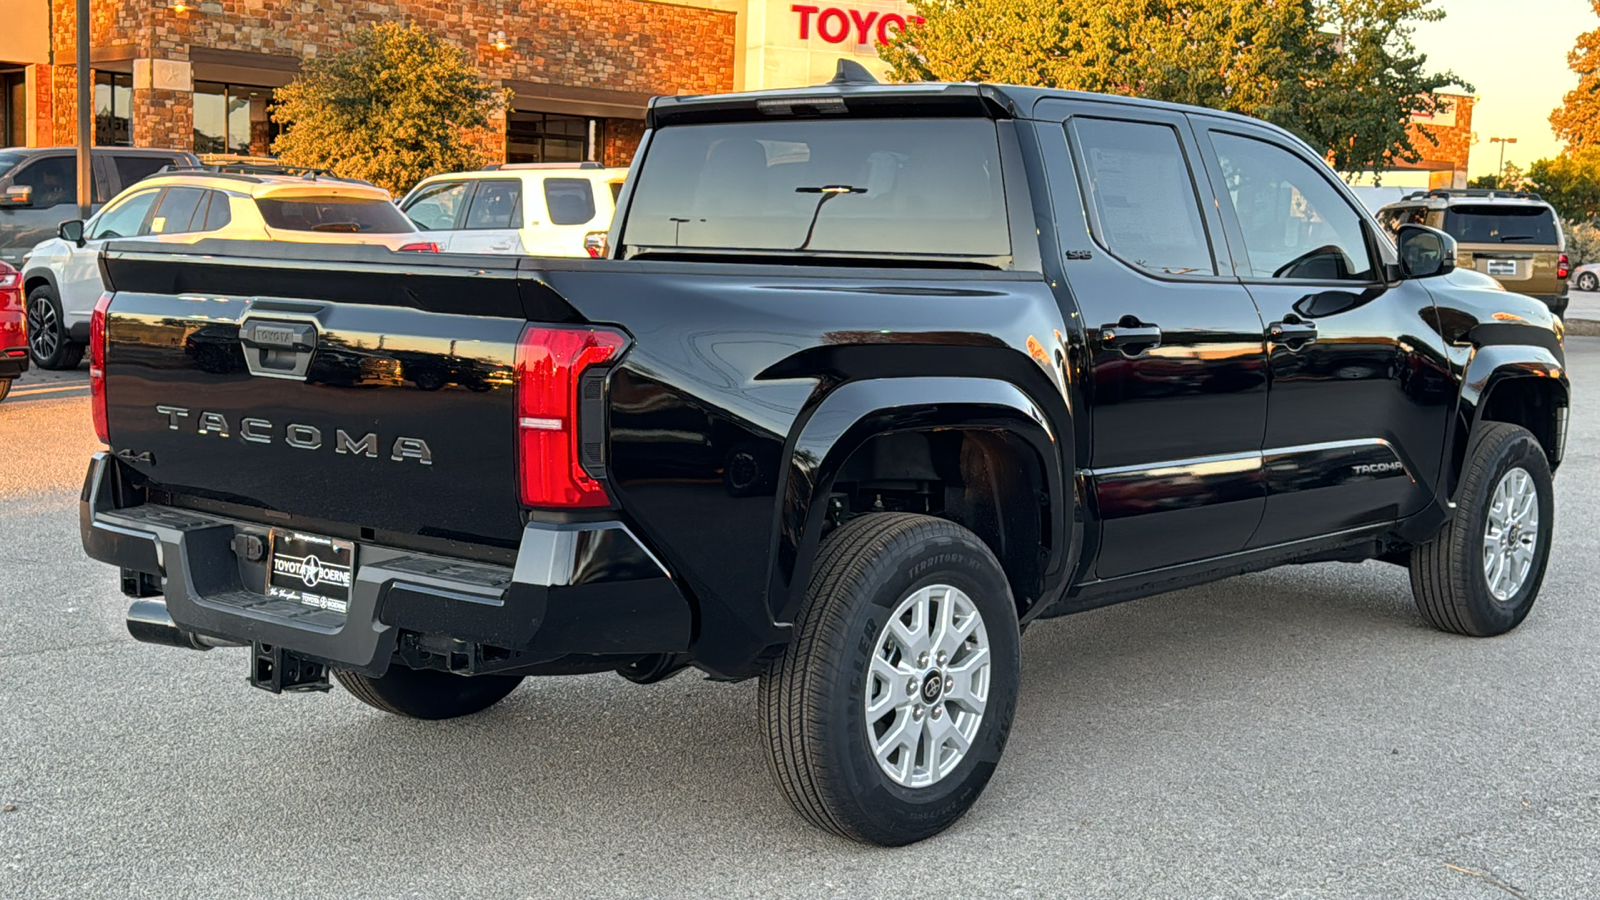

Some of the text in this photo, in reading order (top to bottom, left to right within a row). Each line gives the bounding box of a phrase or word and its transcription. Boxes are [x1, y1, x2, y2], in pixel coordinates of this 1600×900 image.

[791, 4, 926, 47] TOYO
[257, 330, 291, 342] TOYOTA
[156, 405, 433, 465] TACOMA
[1351, 461, 1404, 475] TACOMA
[274, 559, 350, 582] TOYOTA BOERNE
[908, 553, 965, 579] TERRITORY
